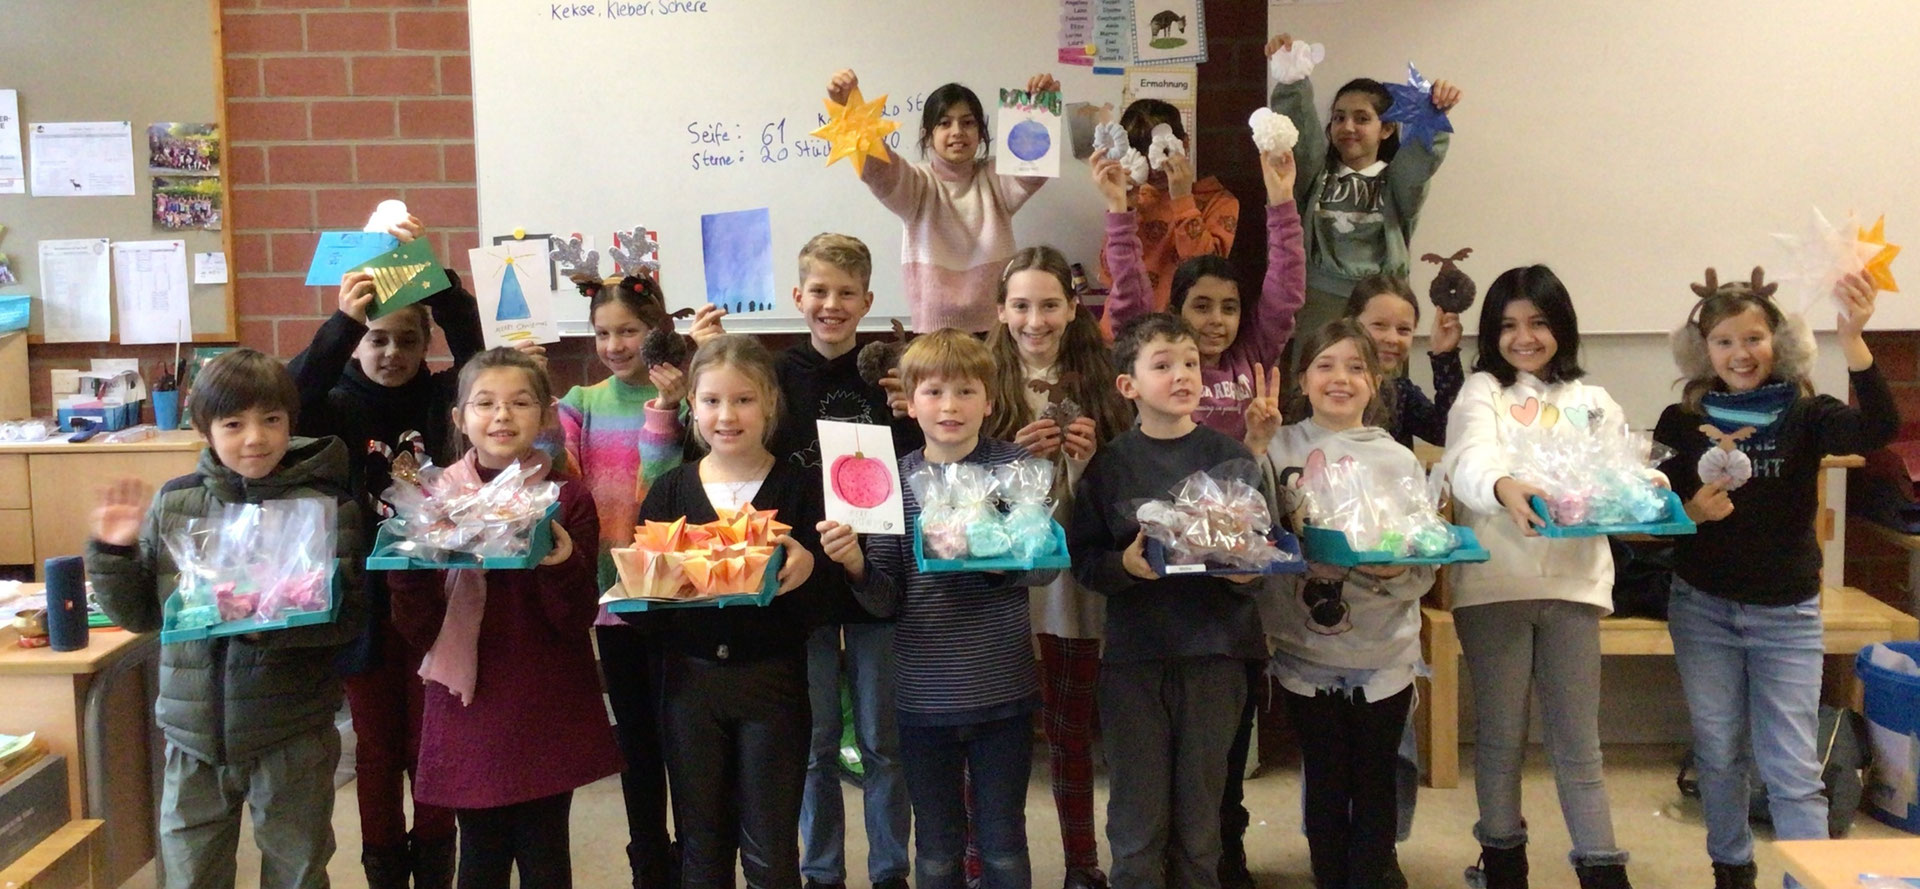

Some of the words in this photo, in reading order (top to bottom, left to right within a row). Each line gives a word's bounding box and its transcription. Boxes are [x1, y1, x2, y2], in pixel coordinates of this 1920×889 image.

[551, 3, 601, 20] Kekse,
[607, 0, 654, 19] Kleber,
[658, 0, 708, 15] Schere
[1140, 78, 1188, 91] Ermahnung
[761, 118, 786, 146] 61
[760, 145, 789, 163] 20
